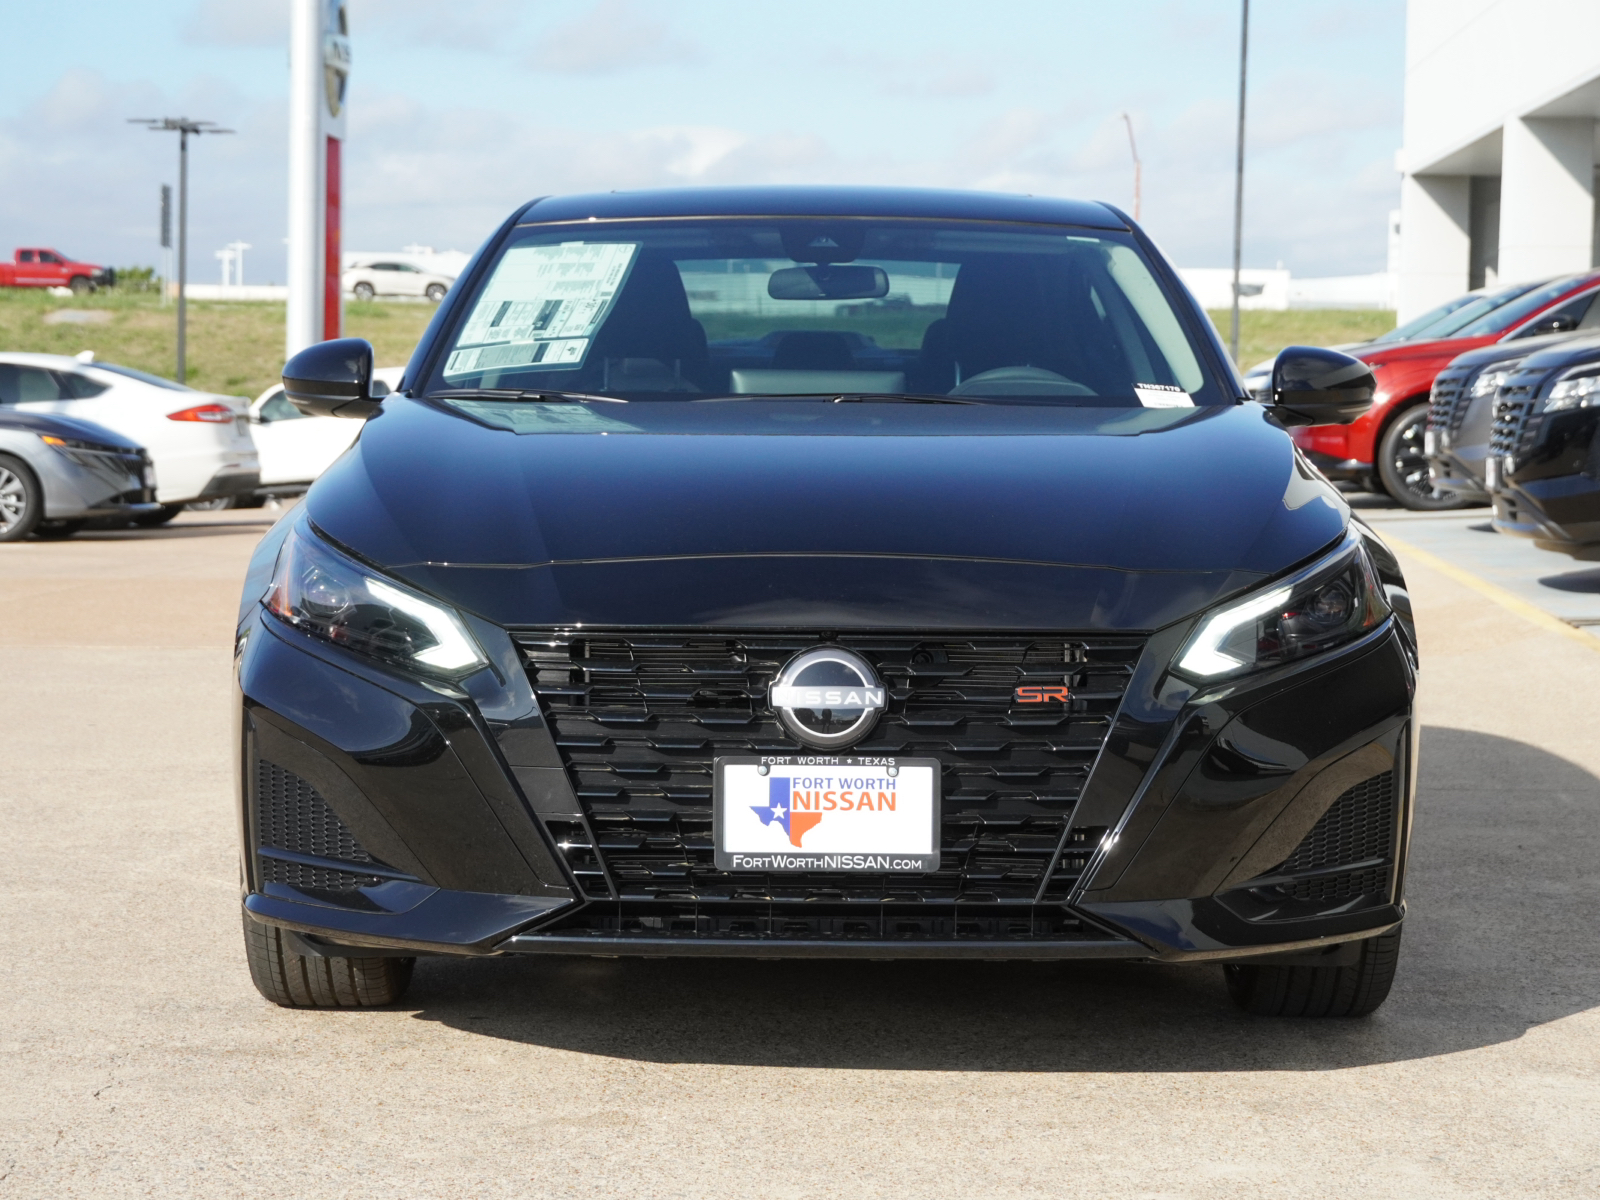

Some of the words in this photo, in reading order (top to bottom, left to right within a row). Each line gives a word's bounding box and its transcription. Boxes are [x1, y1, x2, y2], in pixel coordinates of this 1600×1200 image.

[775, 691, 882, 705] NISSAN
[1015, 686, 1069, 703] SR
[761, 756, 791, 765] FORT
[797, 757, 839, 765] WORTH
[858, 757, 896, 766] TEXAS
[792, 777, 834, 789] FORT
[838, 778, 896, 790] WORTH
[792, 791, 896, 811] NISSAN
